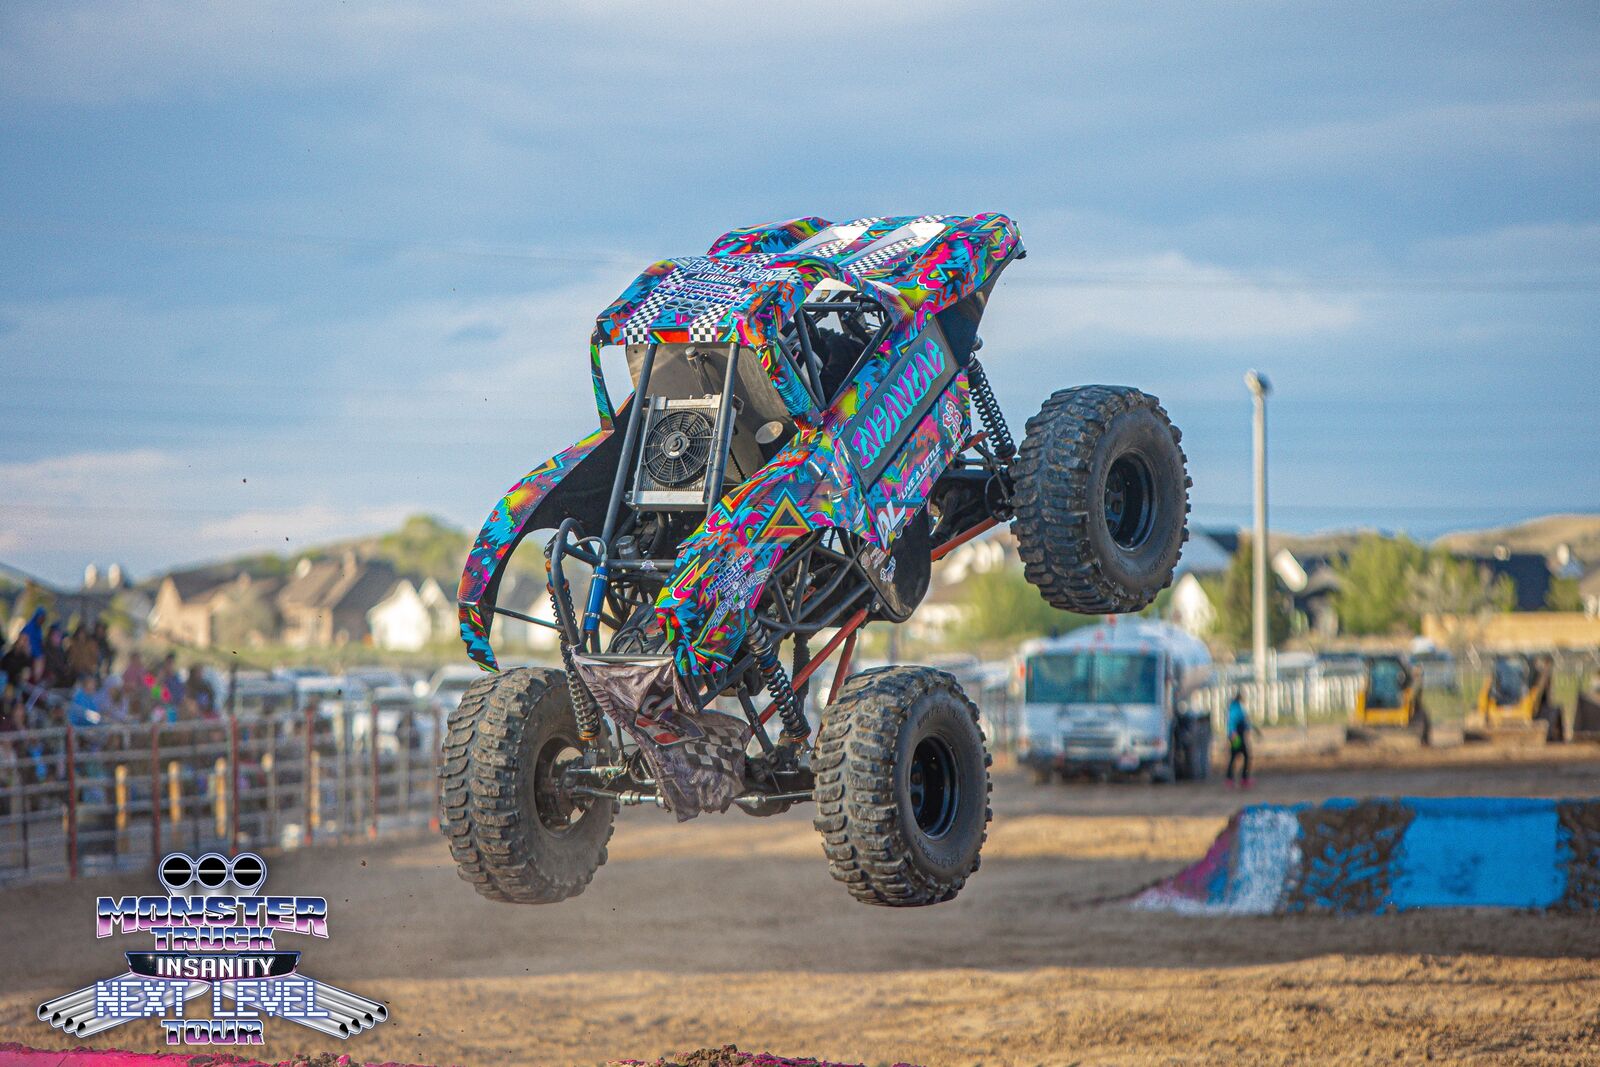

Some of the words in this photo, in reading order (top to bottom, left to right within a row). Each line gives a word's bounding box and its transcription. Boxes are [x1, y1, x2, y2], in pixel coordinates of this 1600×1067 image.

[692, 273, 741, 285] INSANITY
[851, 337, 945, 469] INSANIAC
[920, 442, 941, 471] LITTLE
[724, 574, 748, 597] INSITY
